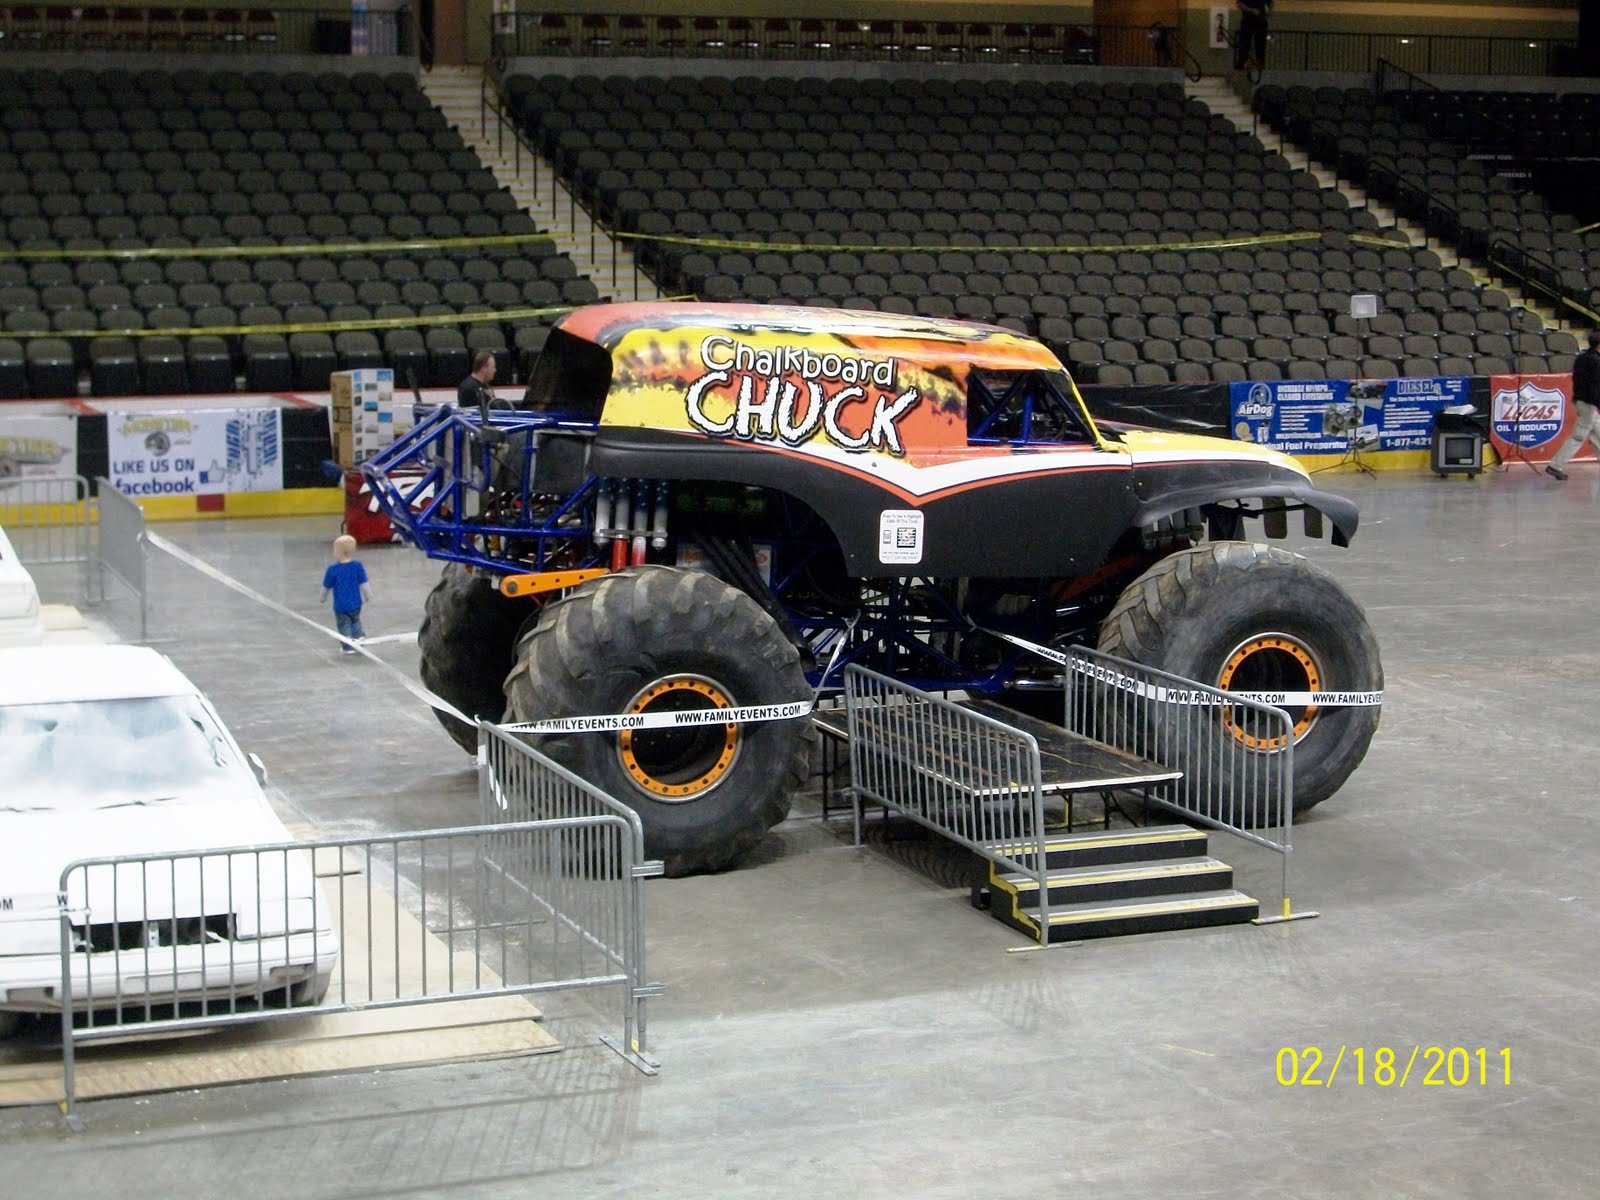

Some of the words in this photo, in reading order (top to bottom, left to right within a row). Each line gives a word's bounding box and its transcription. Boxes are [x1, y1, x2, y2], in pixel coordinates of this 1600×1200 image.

[701, 335, 895, 386] Chalkboard
[686, 371, 918, 453] CHUCK
[1238, 403, 1273, 417] AirDog
[1502, 405, 1558, 420] LUCAS
[1497, 424, 1511, 432] OIL
[1285, 442, 1302, 450] Fuel
[113, 459, 145, 474] LIKE
[151, 459, 169, 471] US
[175, 458, 195, 471] ON
[115, 478, 195, 495] facebook
[675, 705, 801, 723] WWW.FAMILYEVENTS.COM
[511, 716, 645, 730] W.FAMILYEVENTS.COM
